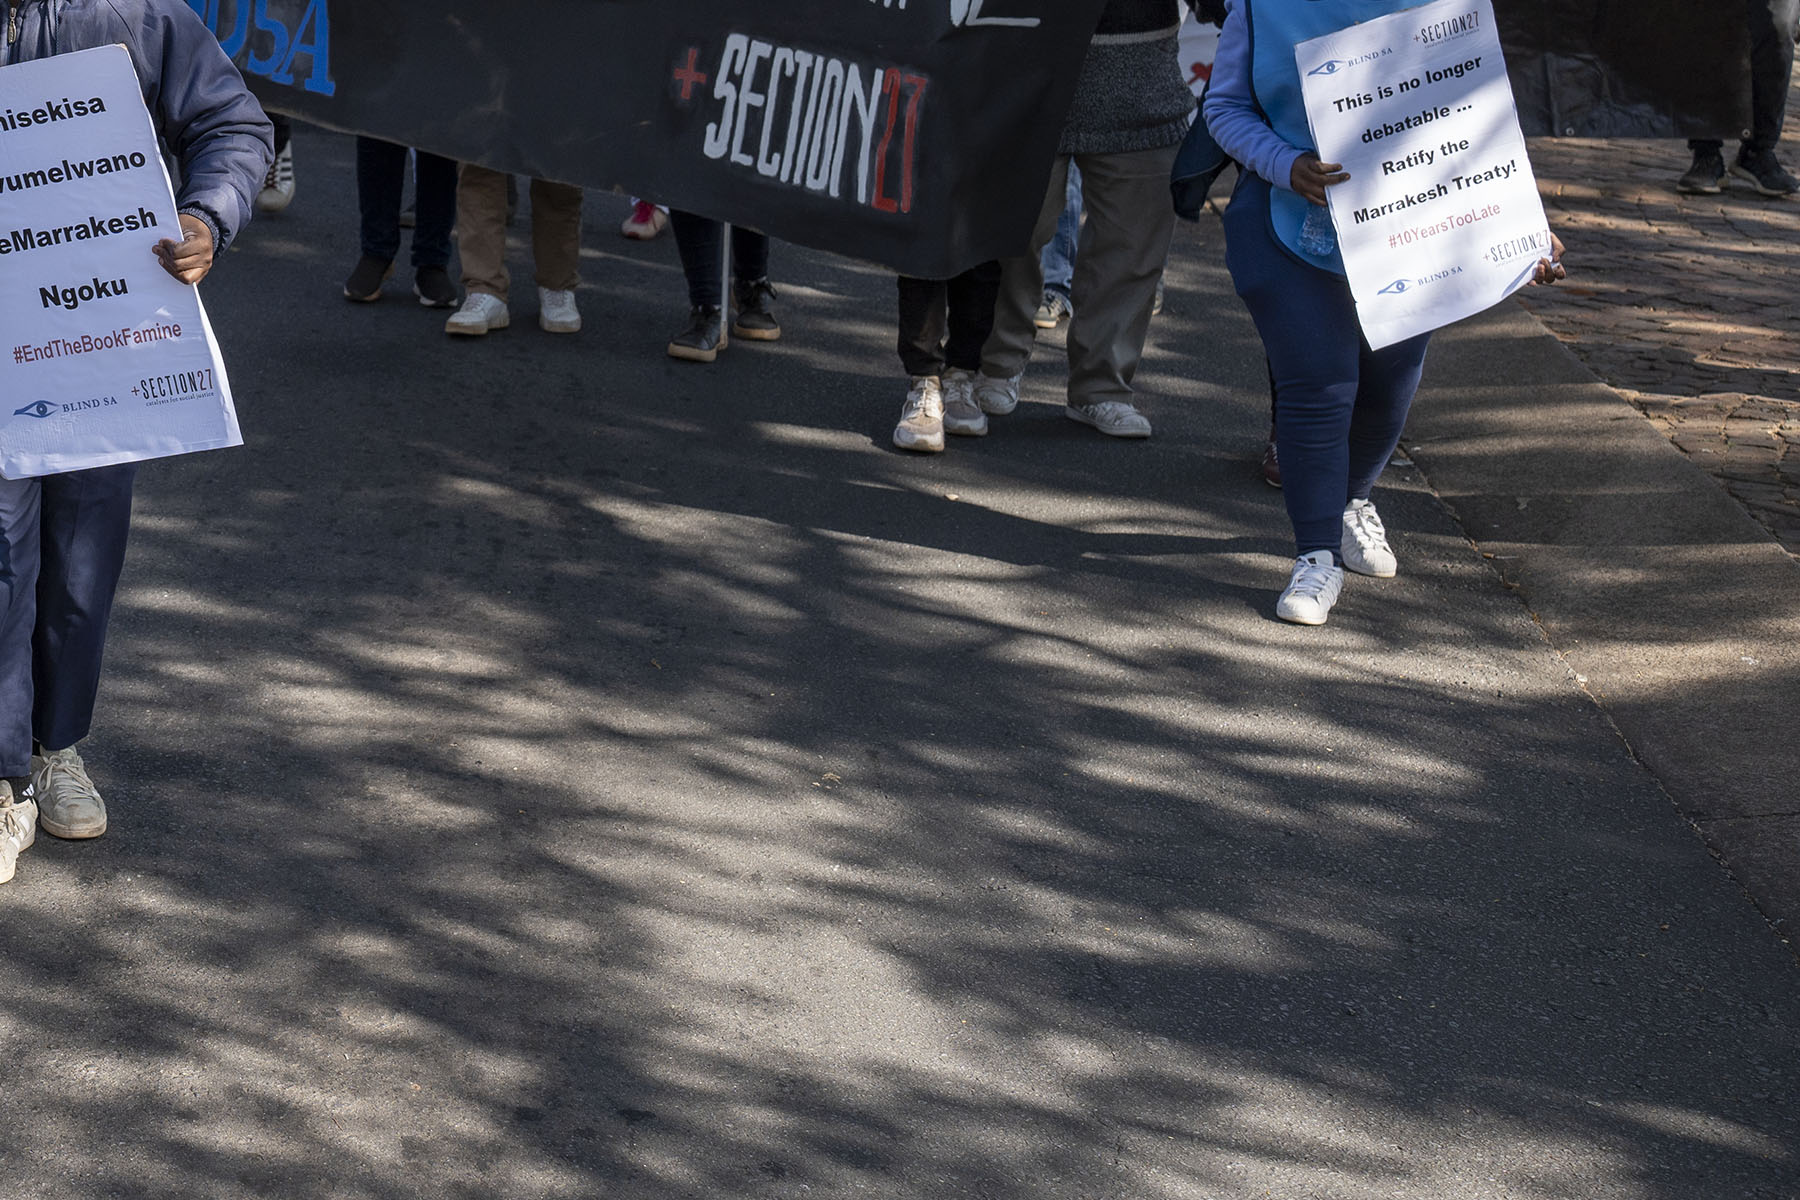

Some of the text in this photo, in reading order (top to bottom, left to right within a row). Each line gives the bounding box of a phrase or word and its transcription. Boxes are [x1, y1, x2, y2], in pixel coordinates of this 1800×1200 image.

[1413, 11, 1479, 44] +SECTION27
[1347, 47, 1393, 67] BLIND SA
[1333, 56, 1482, 113] This is no longer
[1361, 106, 1450, 144] debatable
[1382, 140, 1470, 175] Ratify the
[1353, 159, 1517, 224] Marrakesh Treaty!
[1388, 203, 1501, 248] #10YearsTooLate
[1483, 229, 1550, 263] +SECTION27
[1417, 266, 1463, 286] BLIND SA
[39, 277, 129, 310] Ngoku
[13, 322, 182, 364] #EndTheBookFamine
[131, 368, 213, 400] +SECTION27
[62, 396, 118, 413] BLIND SA
